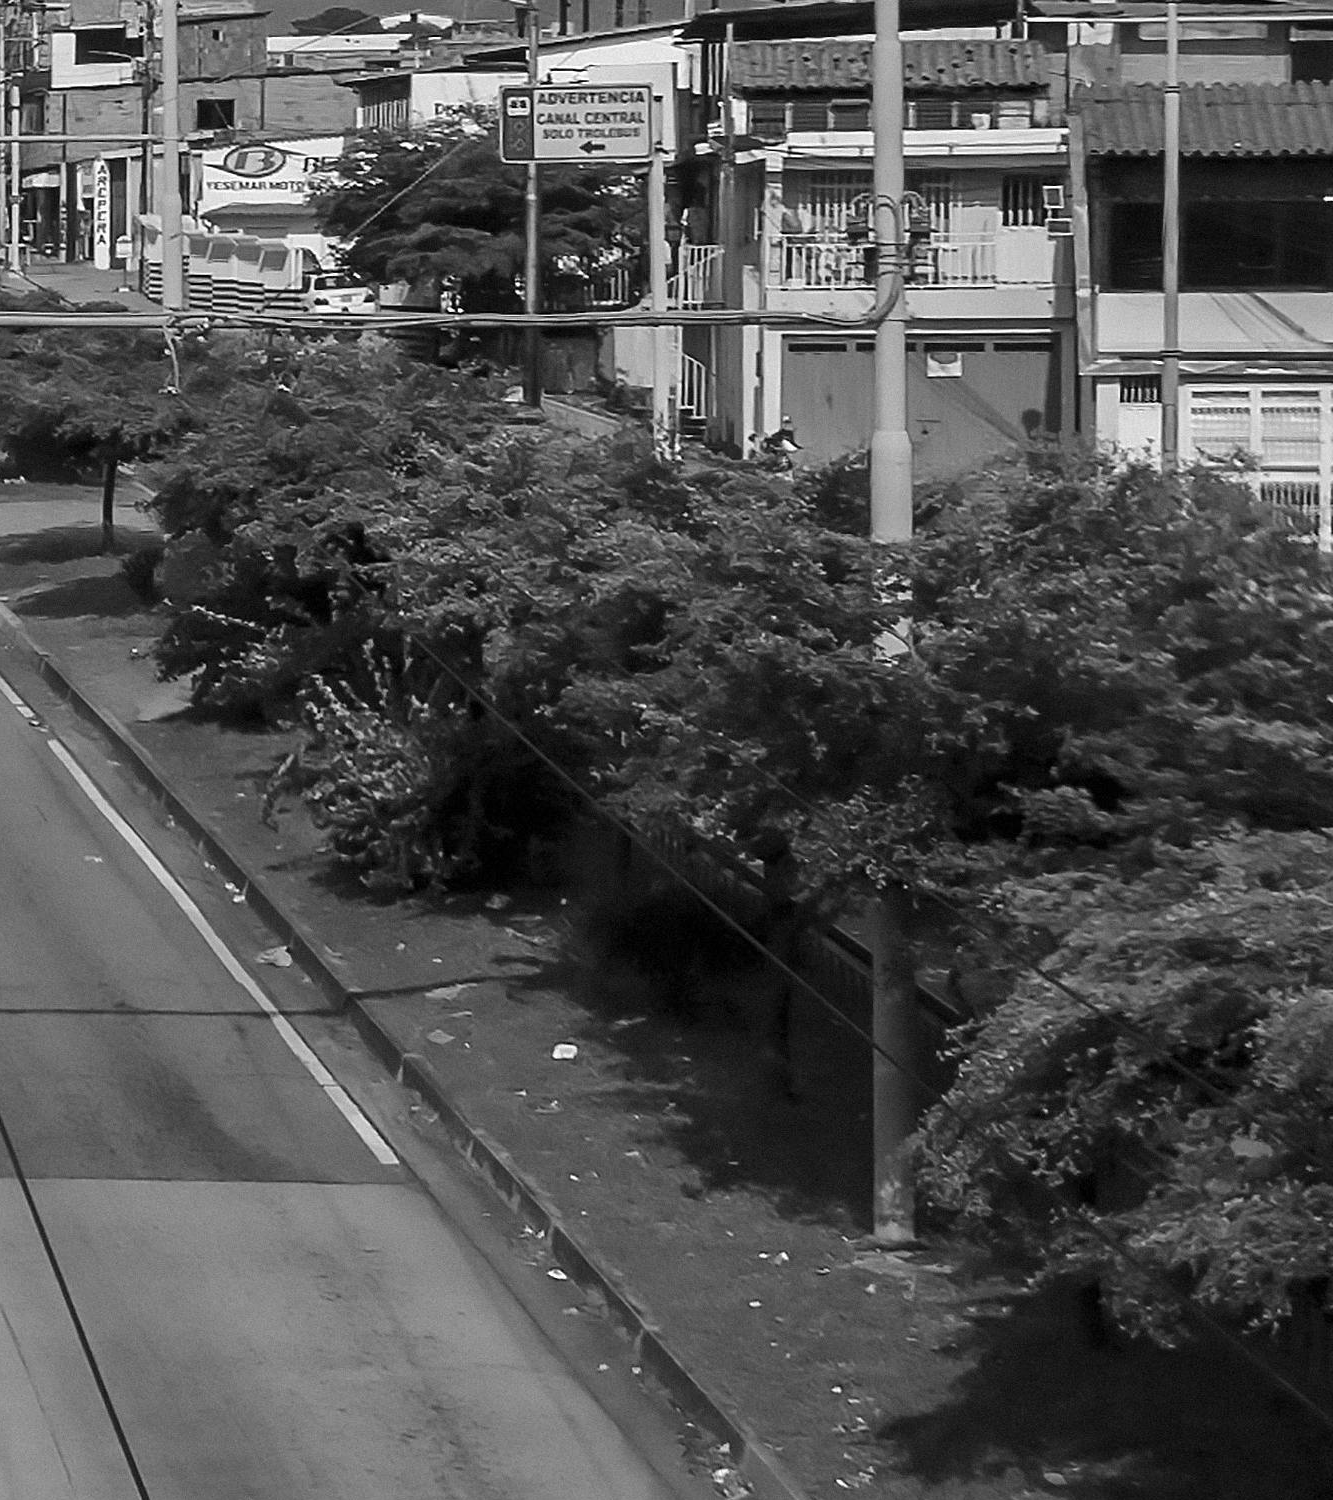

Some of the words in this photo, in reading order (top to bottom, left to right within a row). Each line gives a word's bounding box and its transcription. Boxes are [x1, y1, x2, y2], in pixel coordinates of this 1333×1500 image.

[537, 91, 646, 105] ADVERTENCIA
[536, 112, 581, 126] CANAL
[584, 111, 646, 126] CENTRAL
